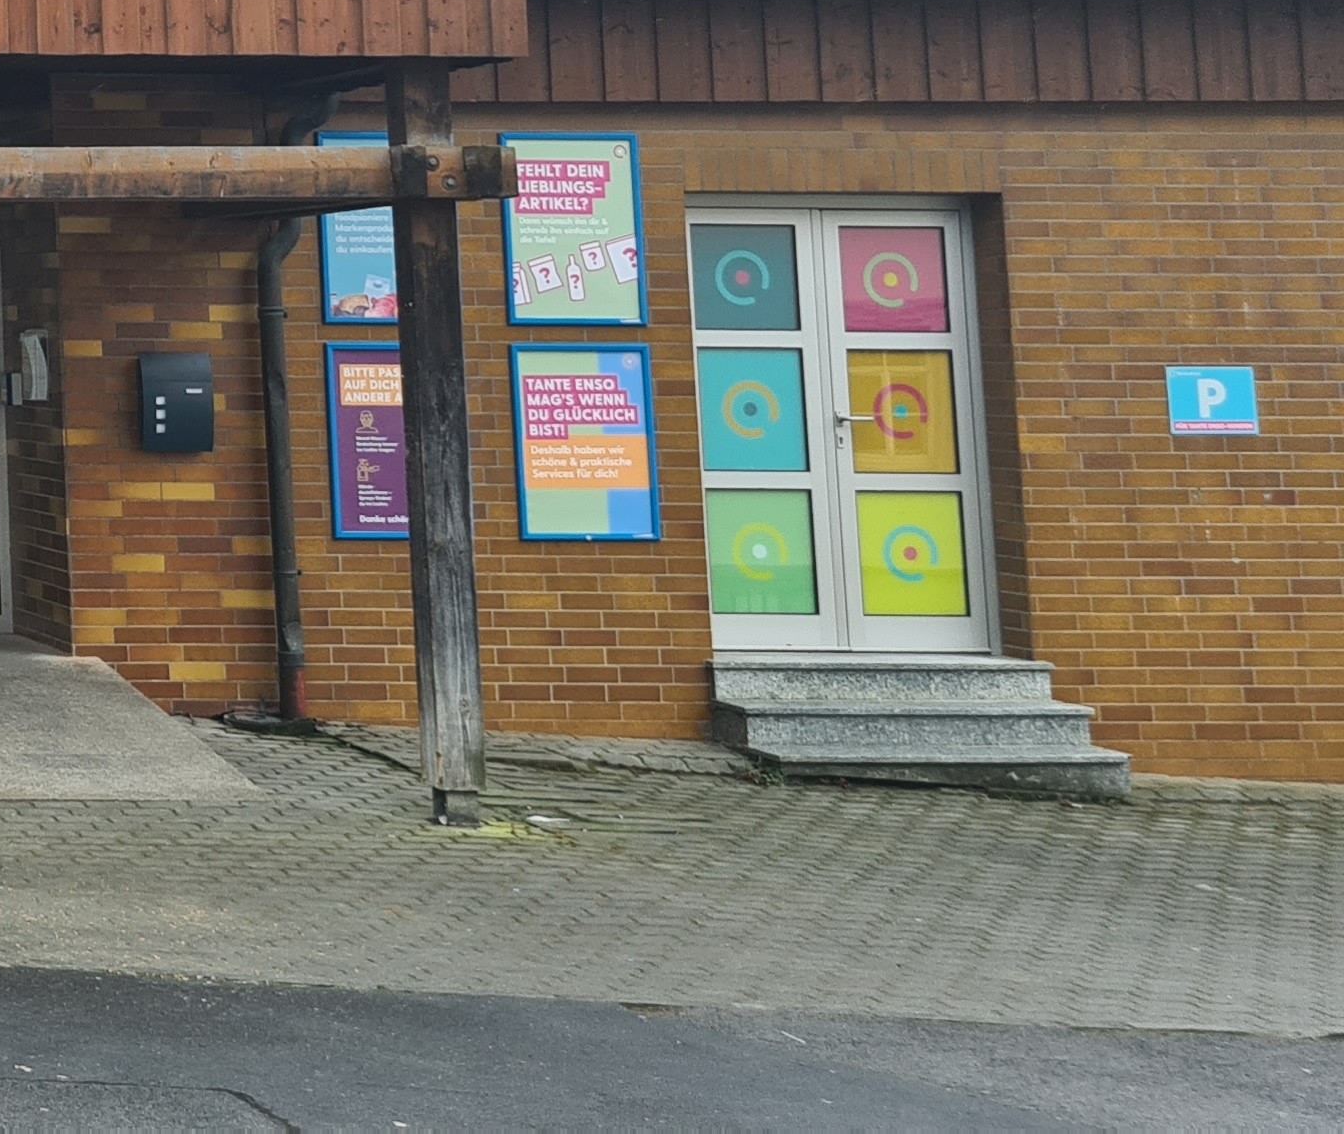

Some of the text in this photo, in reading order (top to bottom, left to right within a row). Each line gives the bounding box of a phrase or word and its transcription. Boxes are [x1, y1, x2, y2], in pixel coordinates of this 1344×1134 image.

[516, 163, 605, 178] FEHLT DEIN
[517, 180, 603, 195] LIEBLINGS-
[518, 196, 589, 211] ARTIKEL?
[335, 224, 394, 234] Markenprodu
[342, 367, 402, 378] BITTE PAS
[343, 379, 399, 390] AUF DICH
[525, 378, 616, 391] TANTE ENSO
[344, 392, 403, 403] ANDERE A
[526, 393, 625, 406] MAG'S WENN
[1197, 378, 1226, 419] P
[527, 406, 636, 421] DU GLÜCKLICH
[529, 424, 566, 437] BIST!
[530, 445, 572, 455] Deshalb
[573, 445, 606, 455] haben
[531, 456, 567, 467] schöne
[579, 456, 633, 468] praktische
[531, 468, 575, 479] Services
[576, 468, 593, 478] für
